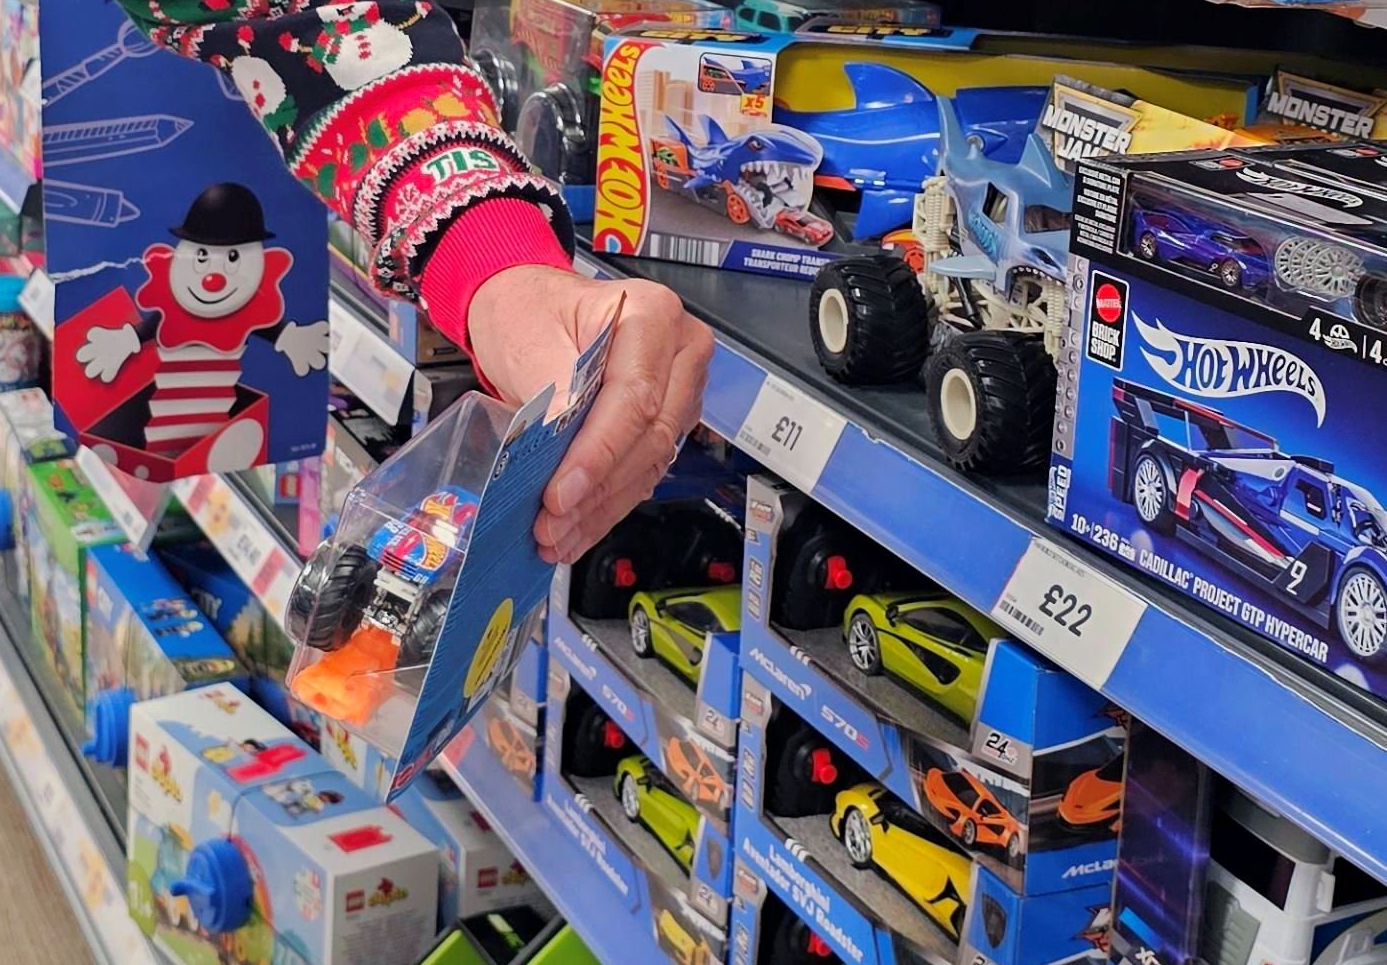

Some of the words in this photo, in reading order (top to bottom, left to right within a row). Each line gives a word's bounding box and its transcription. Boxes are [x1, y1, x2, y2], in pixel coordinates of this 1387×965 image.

[641, 29, 746, 43] CITY
[1042, 104, 1133, 156] MONSTER
[1267, 91, 1374, 140] MONSTER
[426, 148, 497, 181] TIS
[595, 156, 646, 251] HOT
[1095, 297, 1122, 311] MATTEL
[1091, 320, 1121, 348] BRICK
[1184, 340, 1230, 395] HOT
[771, 415, 804, 452] £11
[1055, 465, 1071, 522] SPEED
[1038, 585, 1092, 637] £22
[1071, 513, 1091, 535] 10+
[1093, 521, 1119, 552] 236
[1138, 549, 1190, 591] CADILLAC
[1193, 576, 1242, 616] PROJECT
[1241, 599, 1265, 626] GTP
[1265, 613, 1330, 664] HYPERCAR
[749, 647, 811, 701] McLaren
[743, 837, 790, 892] Aventador
[791, 884, 816, 915] SVJ
[815, 908, 864, 963] Roadster
[768, 843, 831, 913] Lamborghini
